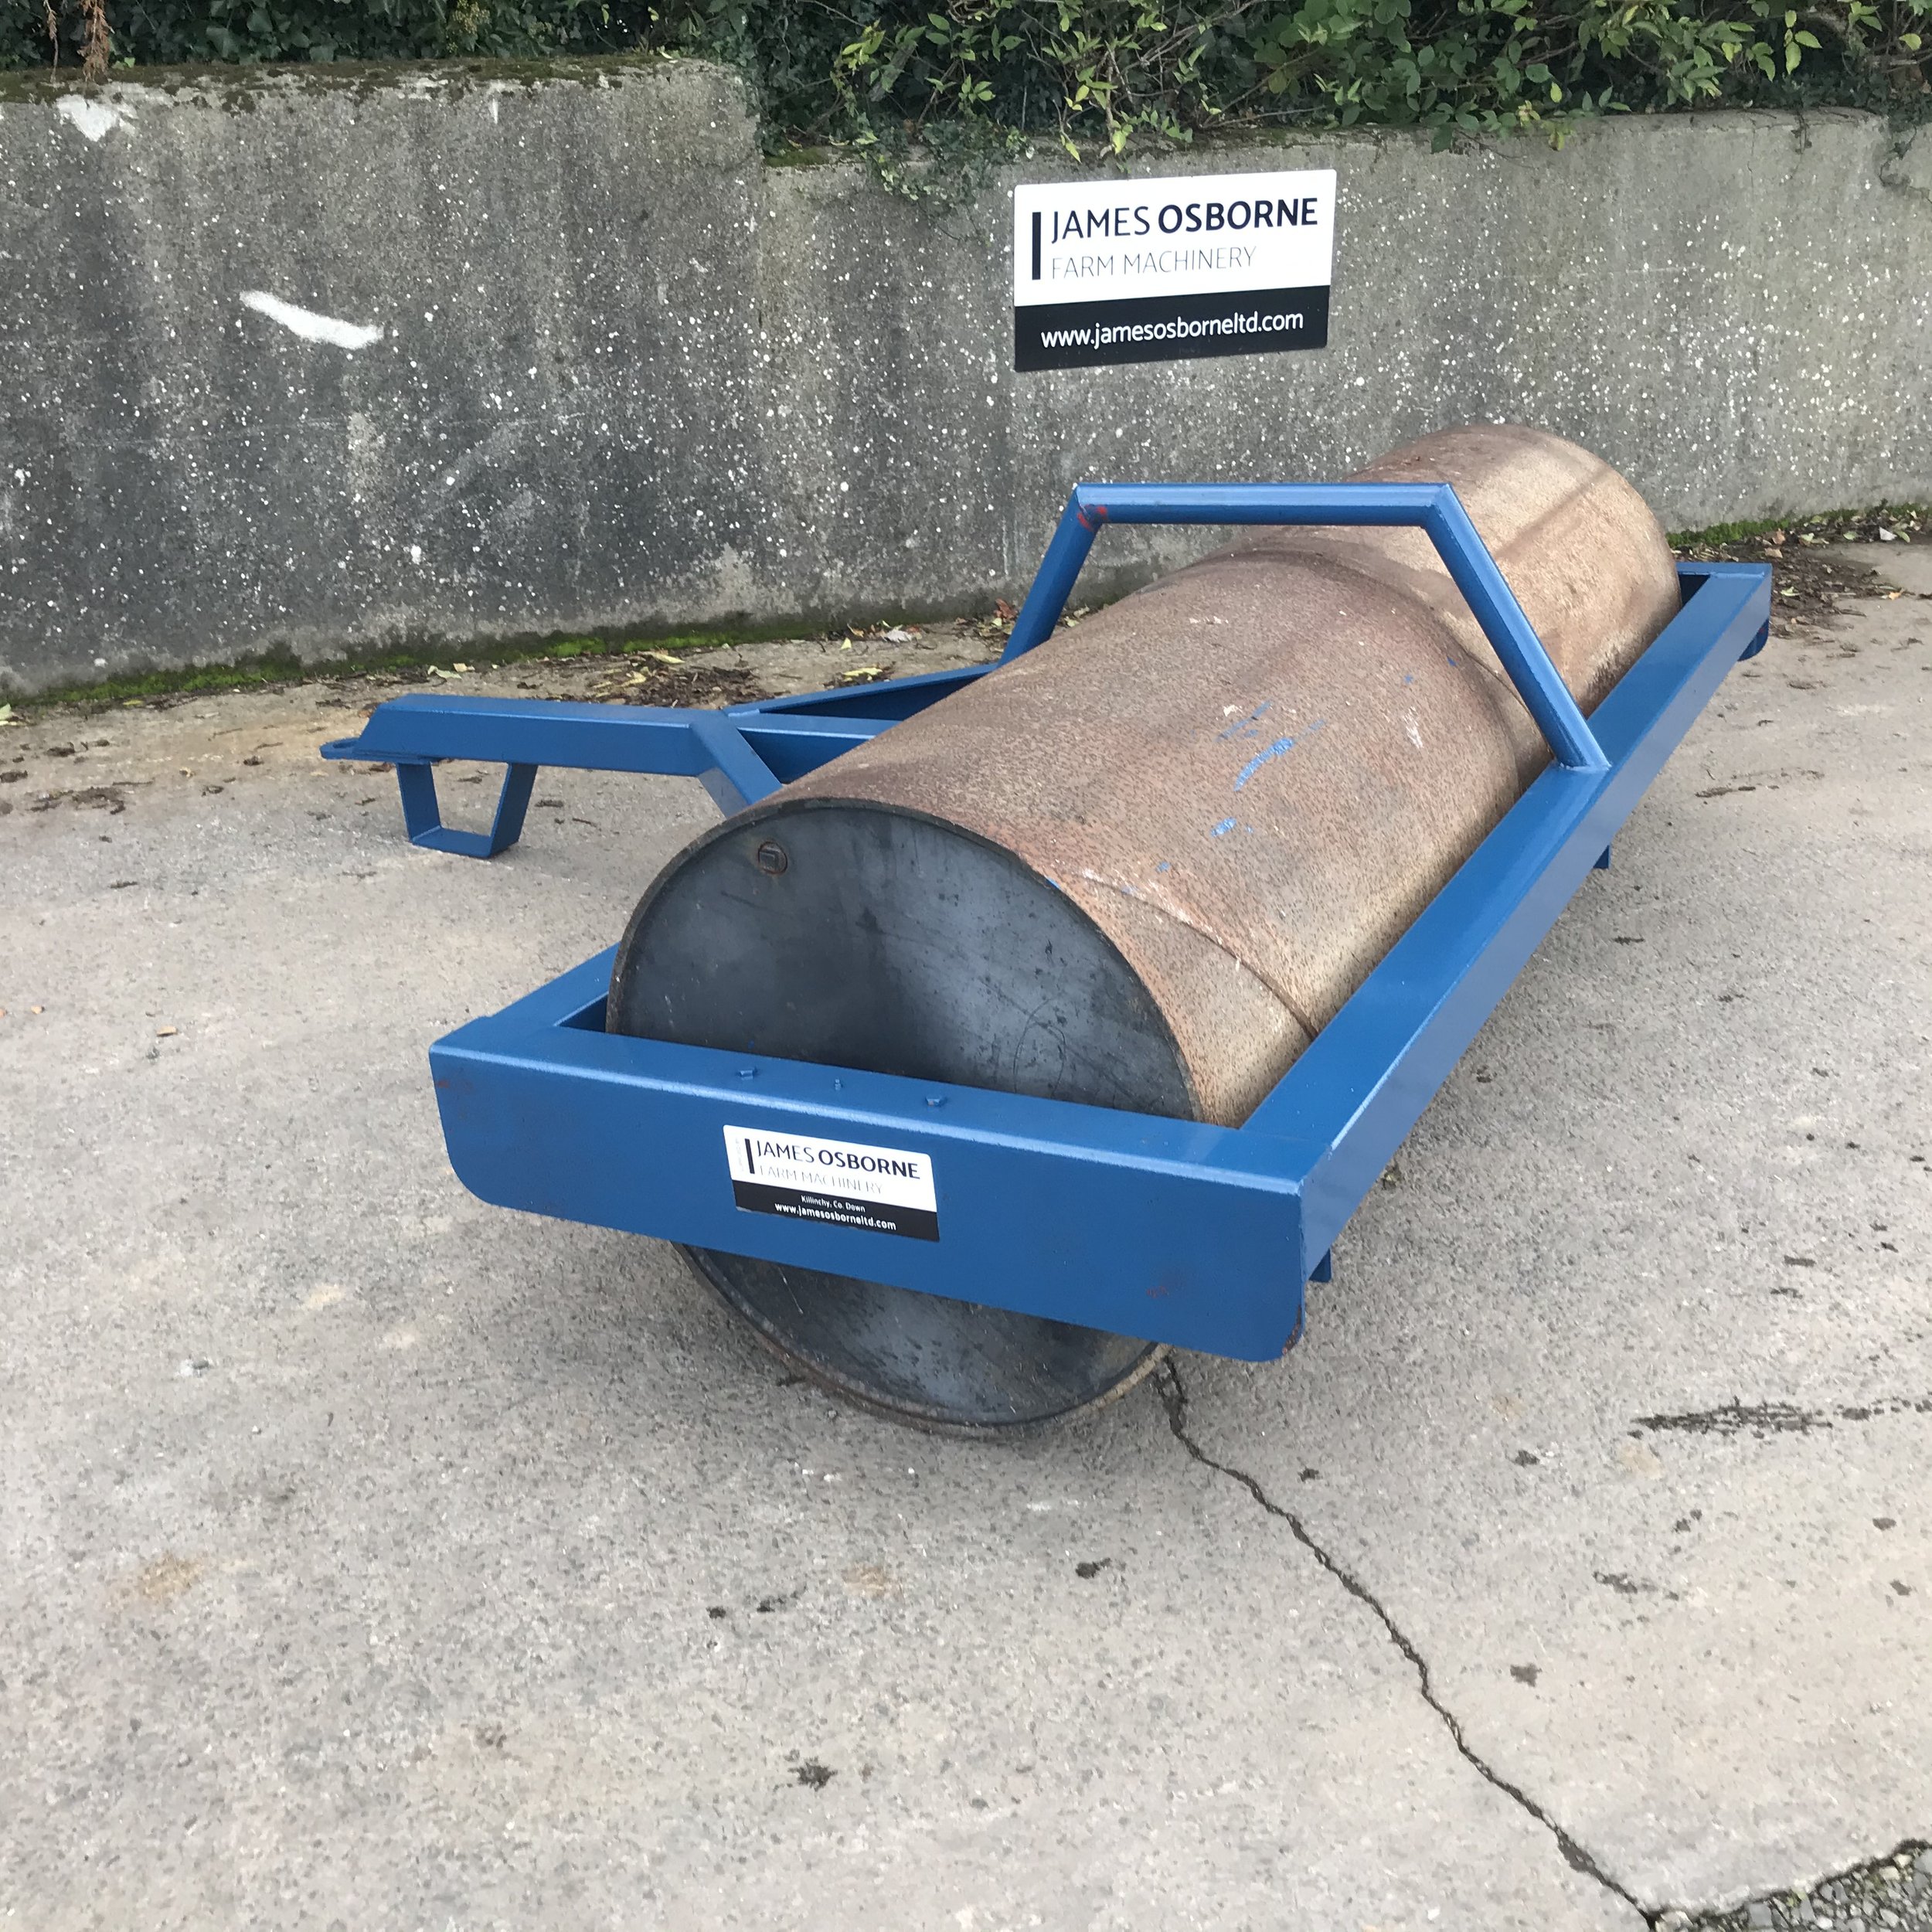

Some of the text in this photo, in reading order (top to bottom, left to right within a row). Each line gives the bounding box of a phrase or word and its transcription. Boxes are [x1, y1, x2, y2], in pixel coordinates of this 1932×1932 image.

[1052, 198, 1318, 244] JAMES OSBORNE
[1052, 246, 1257, 280] FARM MACHINERY
[1041, 311, 1304, 350] www.jamesosborneltd.com
[757, 1140, 815, 1163] JAMES
[818, 1149, 920, 1179] OSBORNE
[774, 1202, 896, 1231] www.jamesosborneltd.com
[832, 1200, 845, 1210] Co.
[845, 1202, 866, 1213] Down
